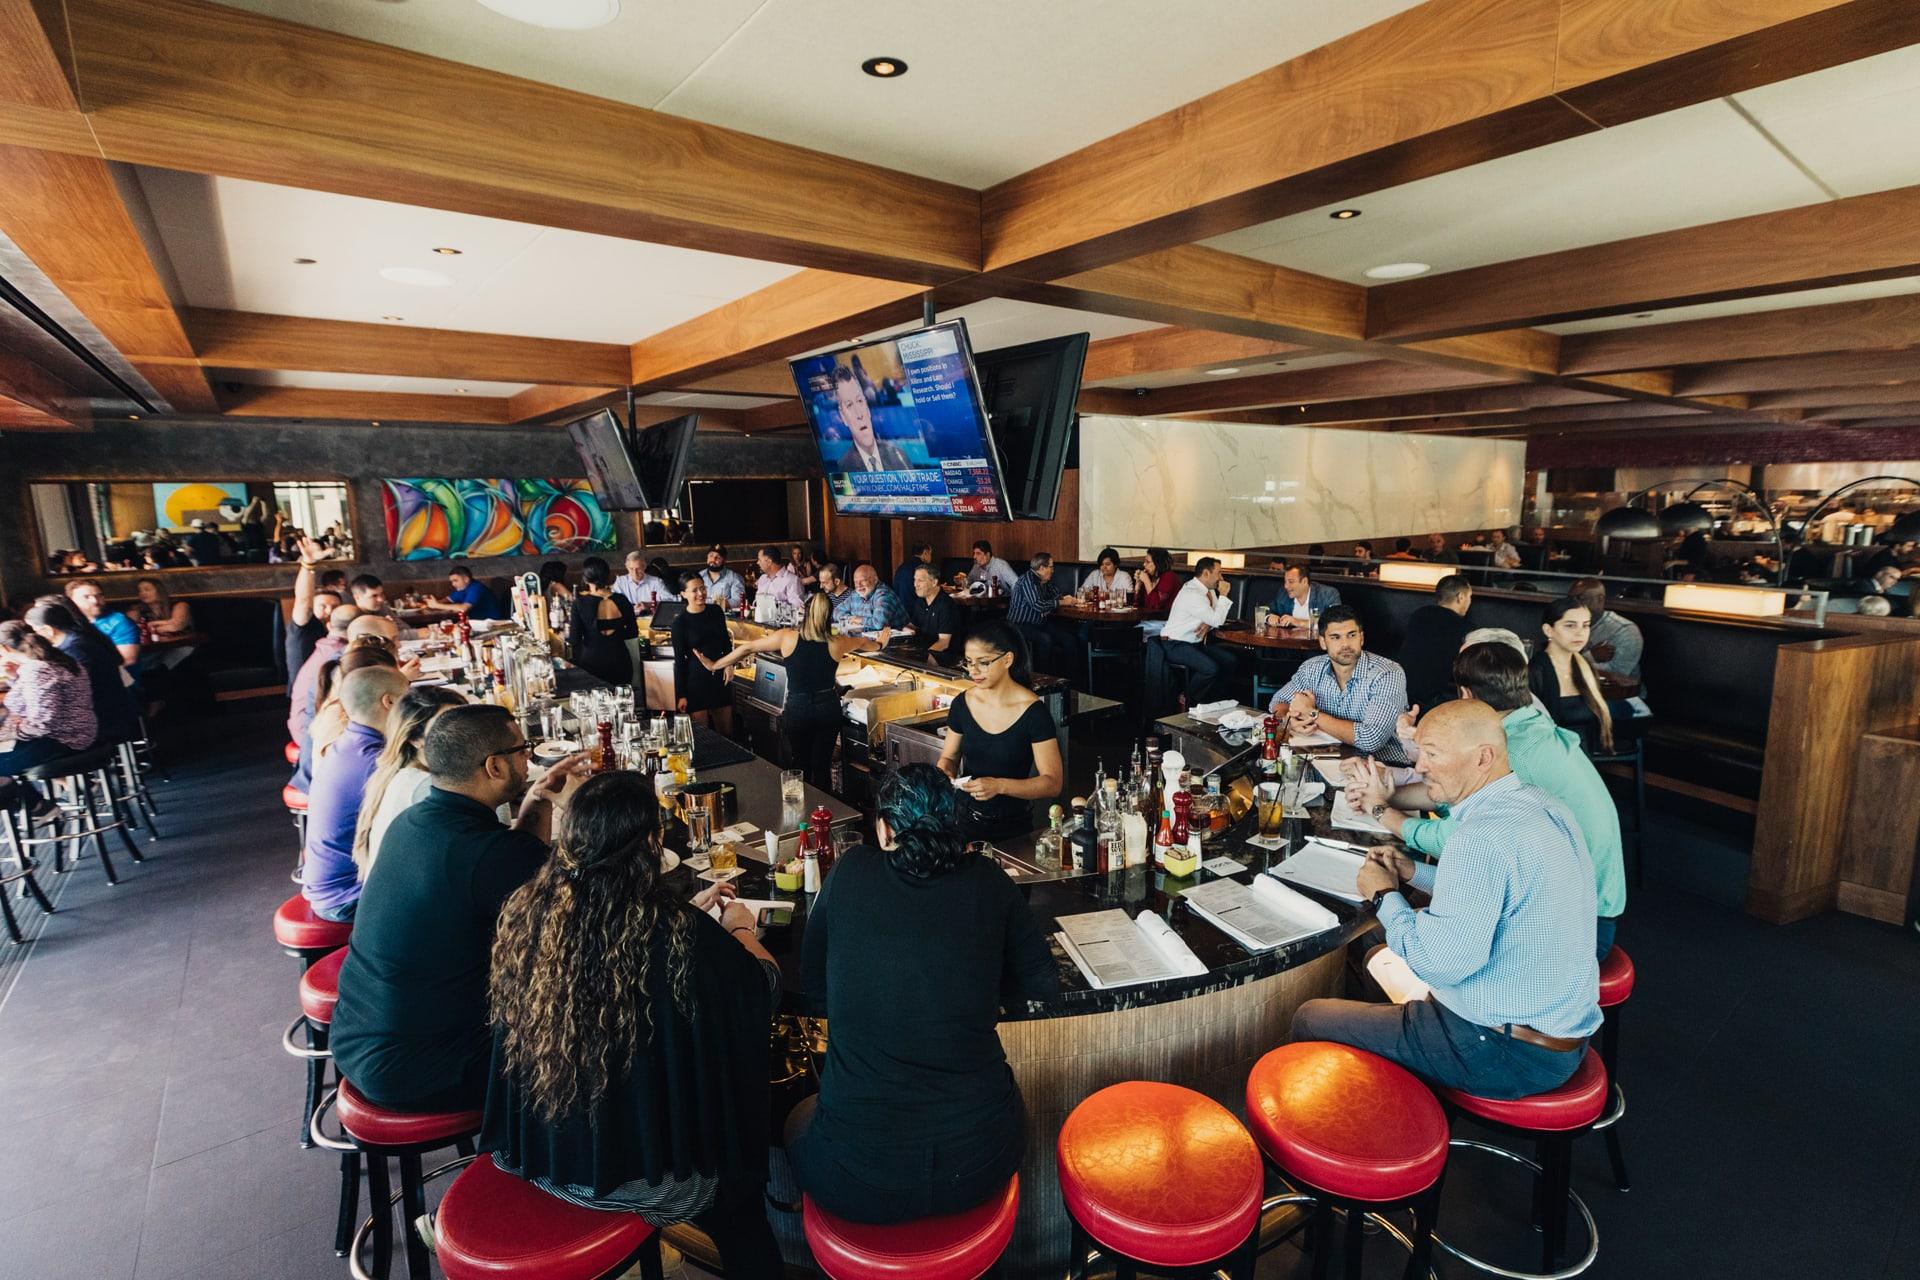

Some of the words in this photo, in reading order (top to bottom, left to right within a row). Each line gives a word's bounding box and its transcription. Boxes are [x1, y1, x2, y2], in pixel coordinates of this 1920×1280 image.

[920, 364, 942, 374] positions
[934, 382, 952, 391] Should
[915, 396, 926, 404] hold
[931, 394, 941, 402] Sell
[941, 391, 956, 400] them?
[852, 474, 868, 484] YOUR
[898, 472, 916, 483] YOUR
